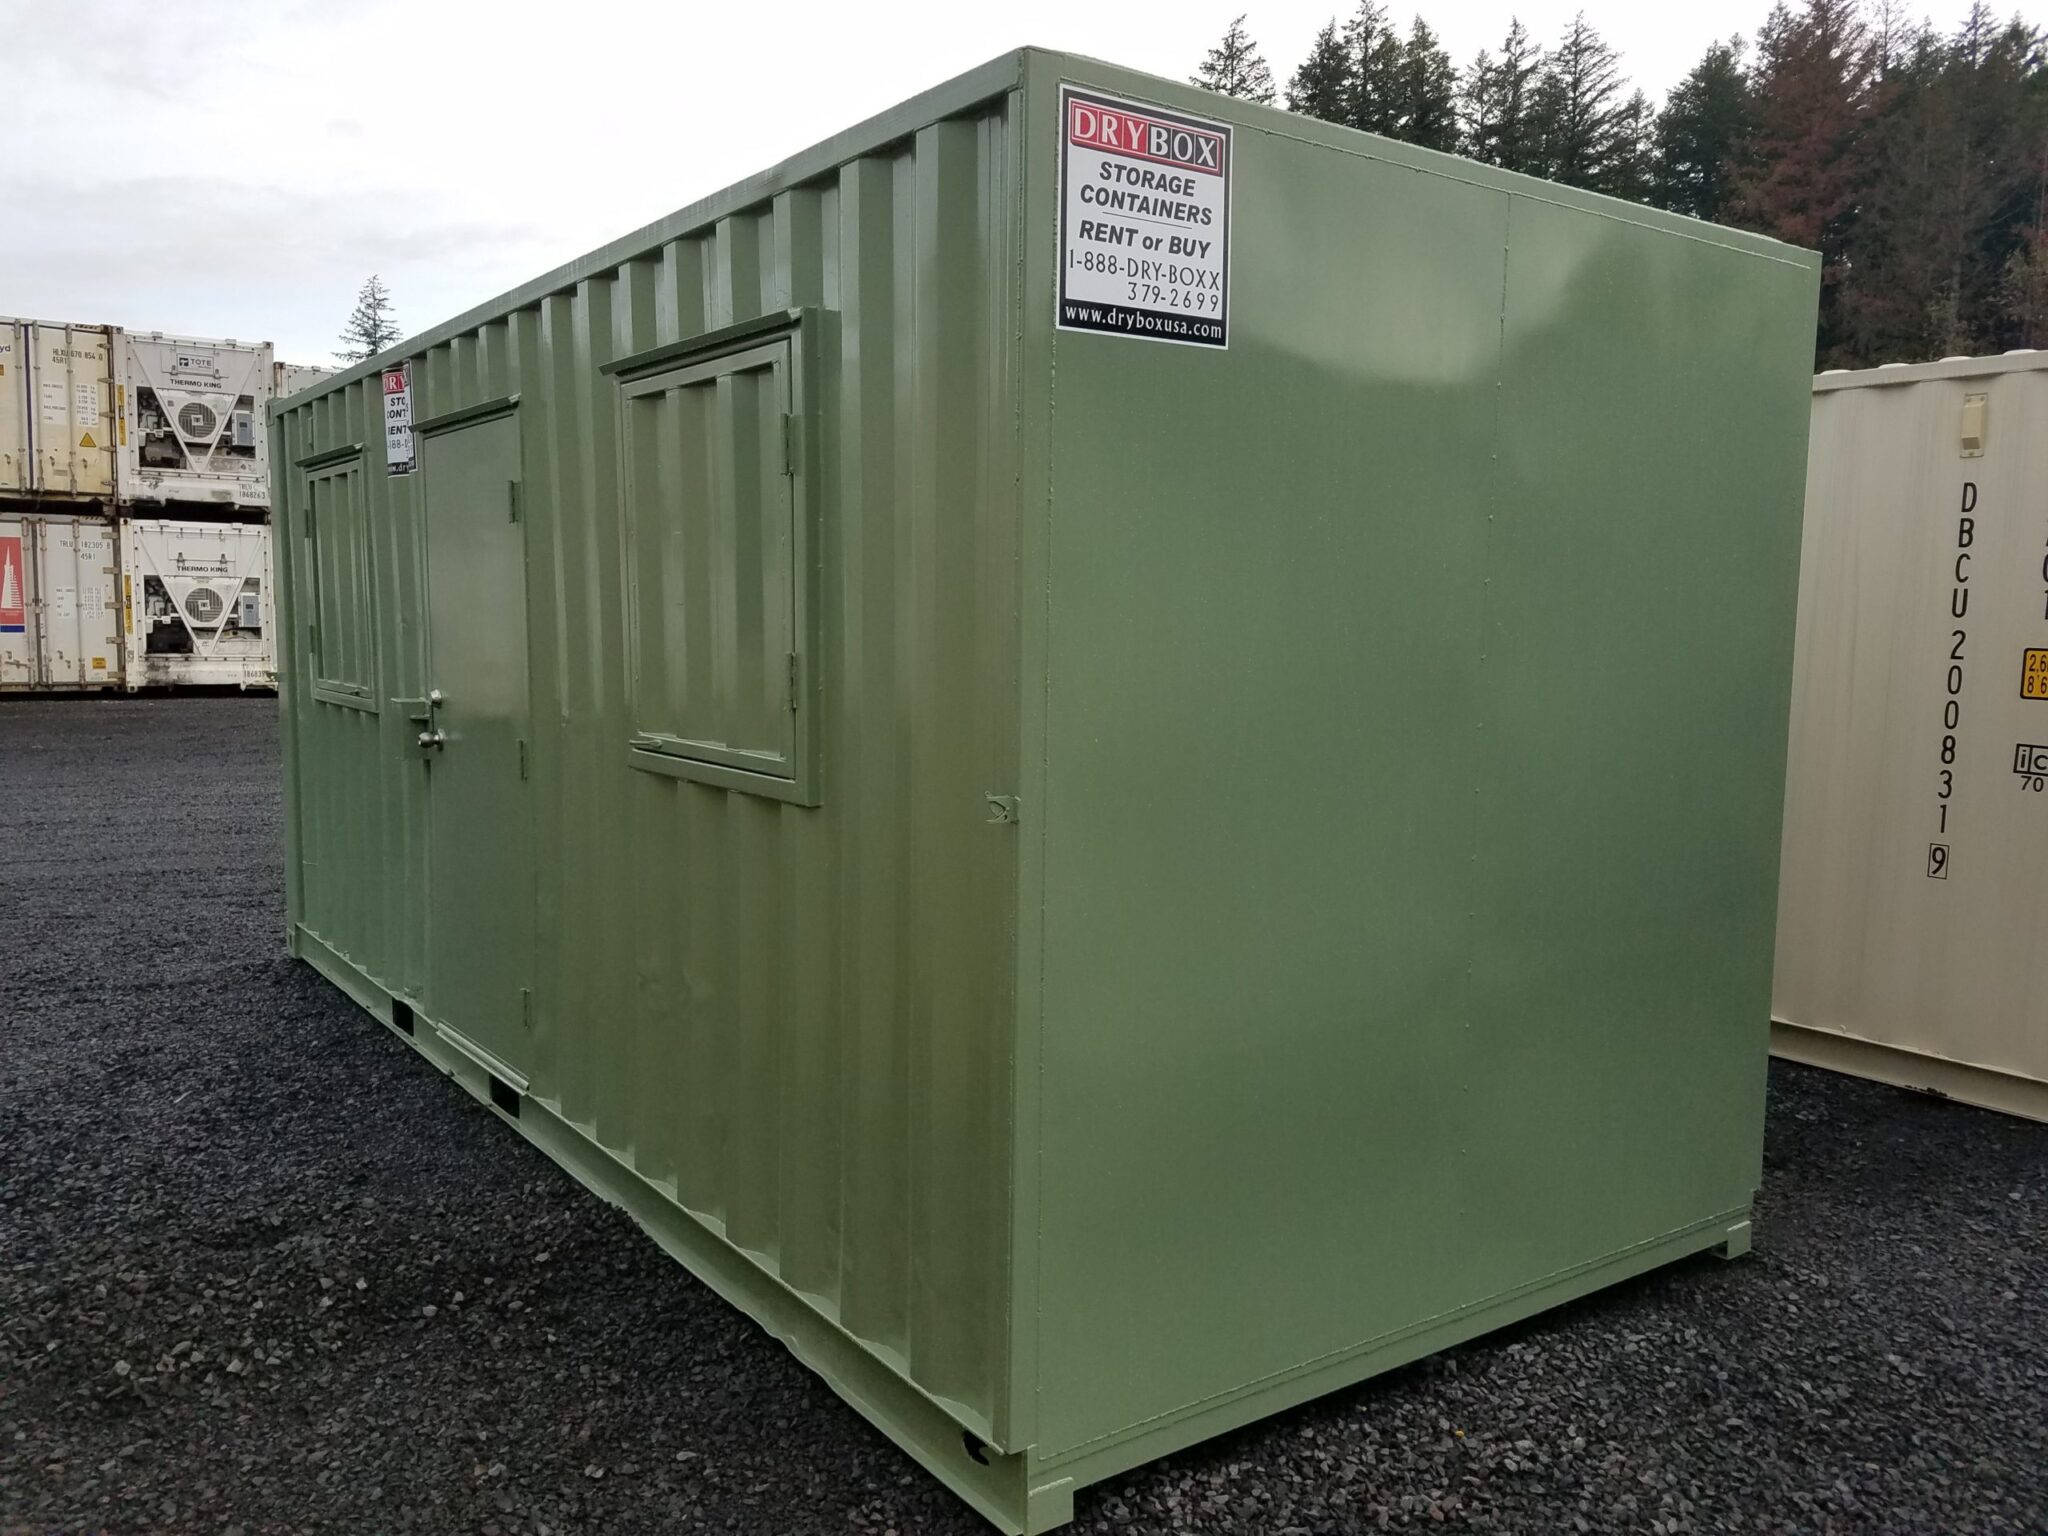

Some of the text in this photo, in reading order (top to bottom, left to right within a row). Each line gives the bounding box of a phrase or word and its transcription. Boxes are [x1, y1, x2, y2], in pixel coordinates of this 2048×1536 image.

[1074, 108, 1216, 167] DRYBOX
[1099, 161, 1196, 197] STORAGE
[1080, 184, 1213, 226] CONTAINERS
[1079, 220, 1211, 259] RENT or BUY
[1069, 248, 1220, 291] 1-888-DRY-BOXX
[1127, 281, 1219, 313] 379-2699
[1065, 304, 1222, 339] www.dryboxusa.com
[190, 358, 212, 366] TOTE
[170, 378, 202, 387] THERMO
[2021, 775, 2044, 793] 70
